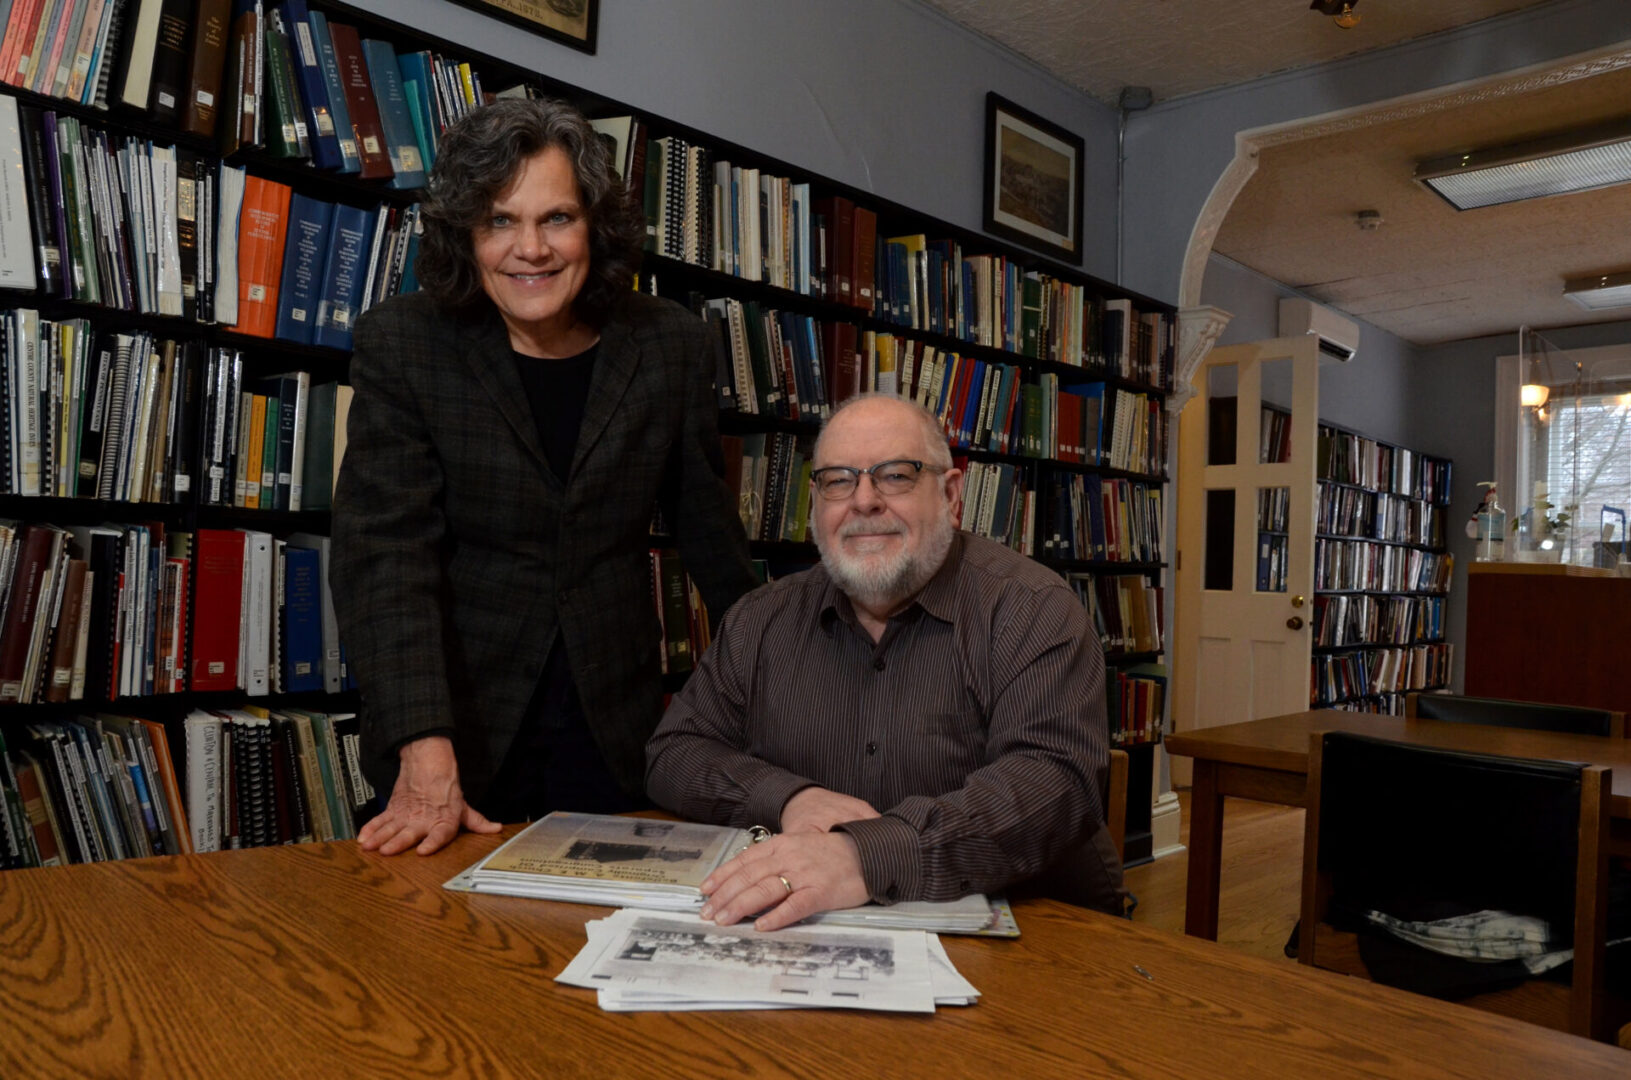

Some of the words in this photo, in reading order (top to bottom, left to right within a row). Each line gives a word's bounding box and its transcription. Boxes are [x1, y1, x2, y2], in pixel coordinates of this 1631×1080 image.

[26, 341, 36, 361] CENTRE
[27, 362, 36, 383] COUNTY
[27, 384, 36, 407] NATURAL
[203, 725, 216, 756] CLINTON
[519, 858, 603, 868] Congregations
[539, 863, 603, 873] Comprised
[509, 865, 553, 873] Church
[608, 865, 666, 875] Separate
[608, 869, 667, 879] Originally
